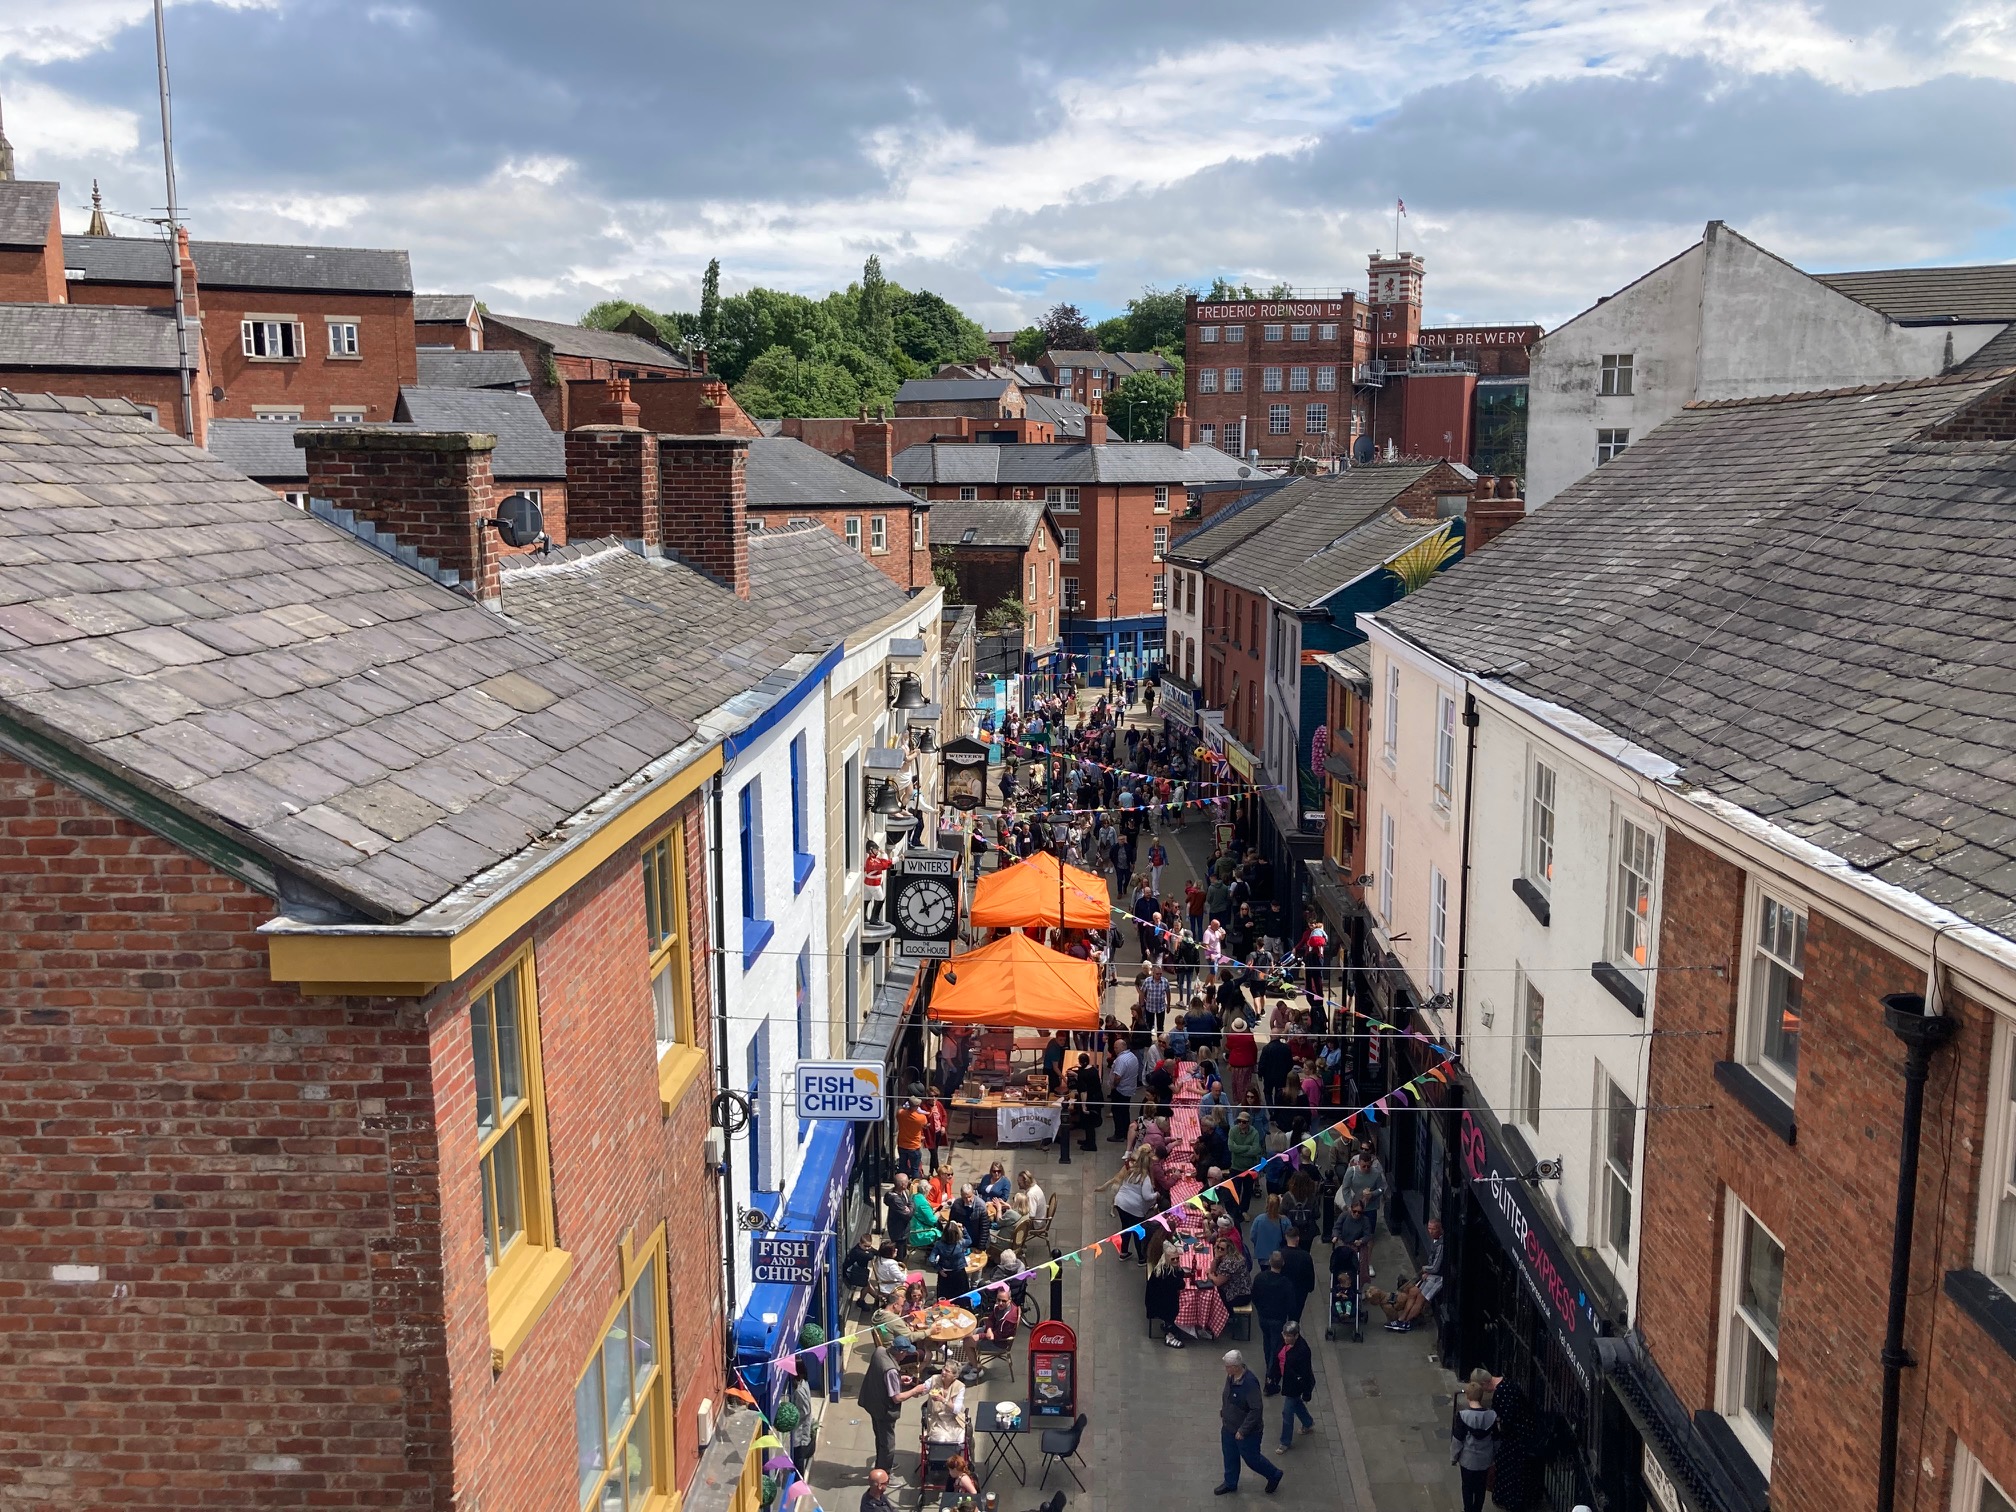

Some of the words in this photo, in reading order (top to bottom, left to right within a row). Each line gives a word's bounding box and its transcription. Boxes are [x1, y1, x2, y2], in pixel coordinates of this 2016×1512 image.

[1197, 304, 1256, 319] FREDERIC
[1261, 303, 1322, 317] ROBINSON
[1328, 303, 1342, 316] LTD
[1381, 332, 1398, 345] LTD
[1456, 331, 1526, 345] BREWERY
[907, 860, 949, 873] WINTER'S
[905, 945, 926, 954] CLOCK
[927, 946, 947, 955] HOUSE
[805, 1076, 854, 1093] FISH
[804, 1094, 873, 1111] CHIPS
[758, 1241, 810, 1258] FISH
[770, 1257, 796, 1266] AND
[754, 1265, 813, 1283] CHIPS
